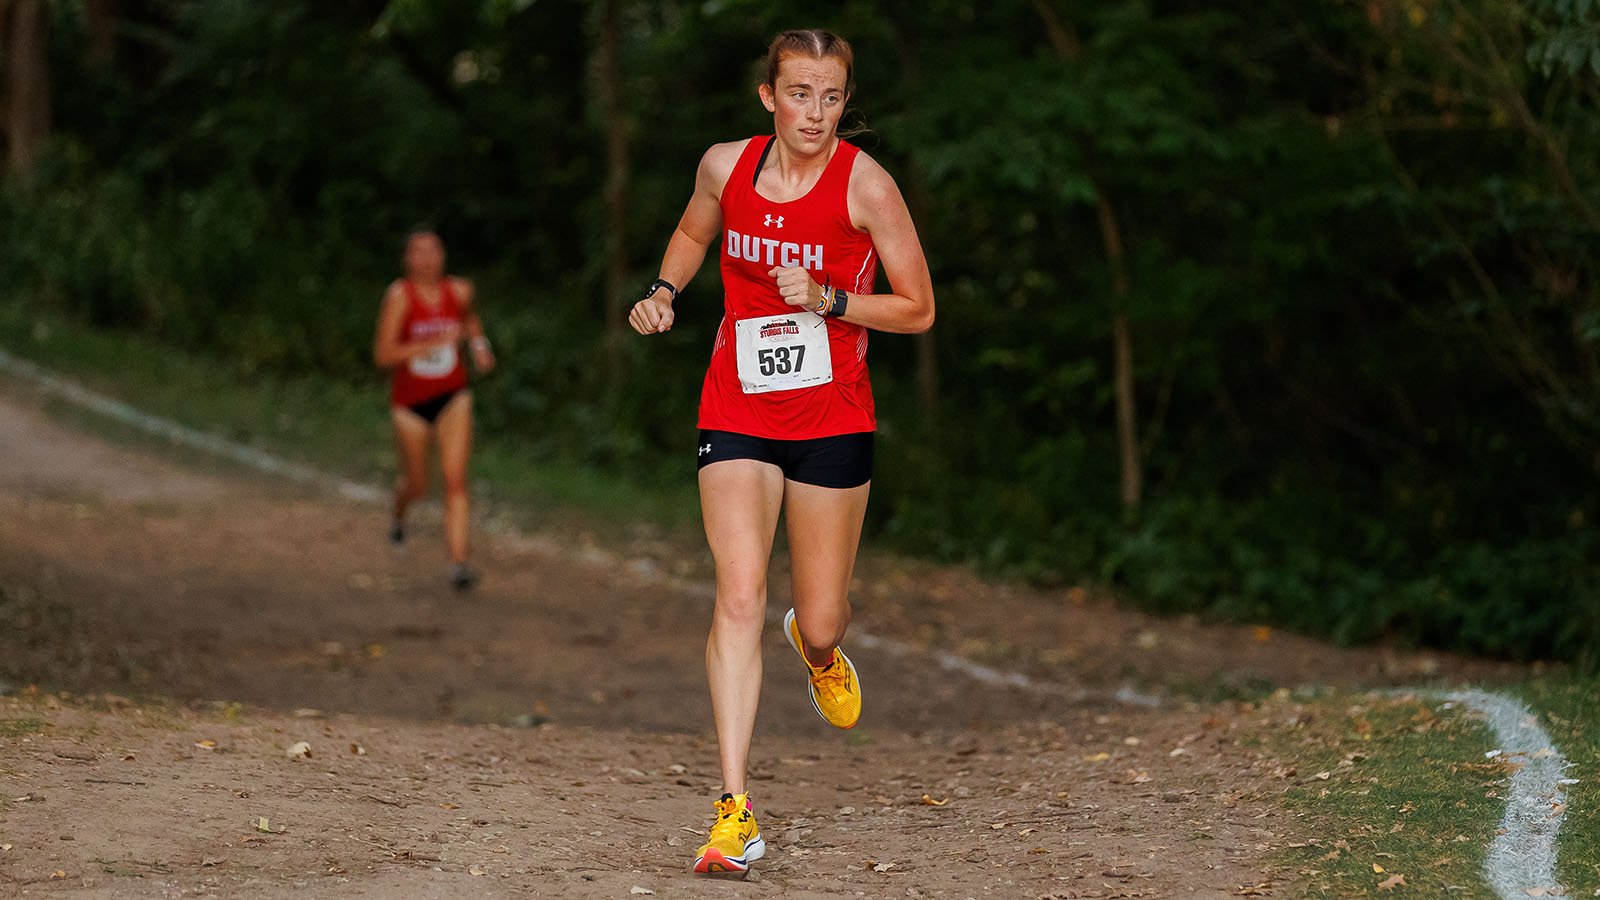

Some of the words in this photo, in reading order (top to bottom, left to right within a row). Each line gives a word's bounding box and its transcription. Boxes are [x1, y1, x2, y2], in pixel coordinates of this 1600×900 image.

[727, 229, 823, 270] DUTCH
[783, 326, 800, 335] FALLS
[758, 345, 806, 377] 537
